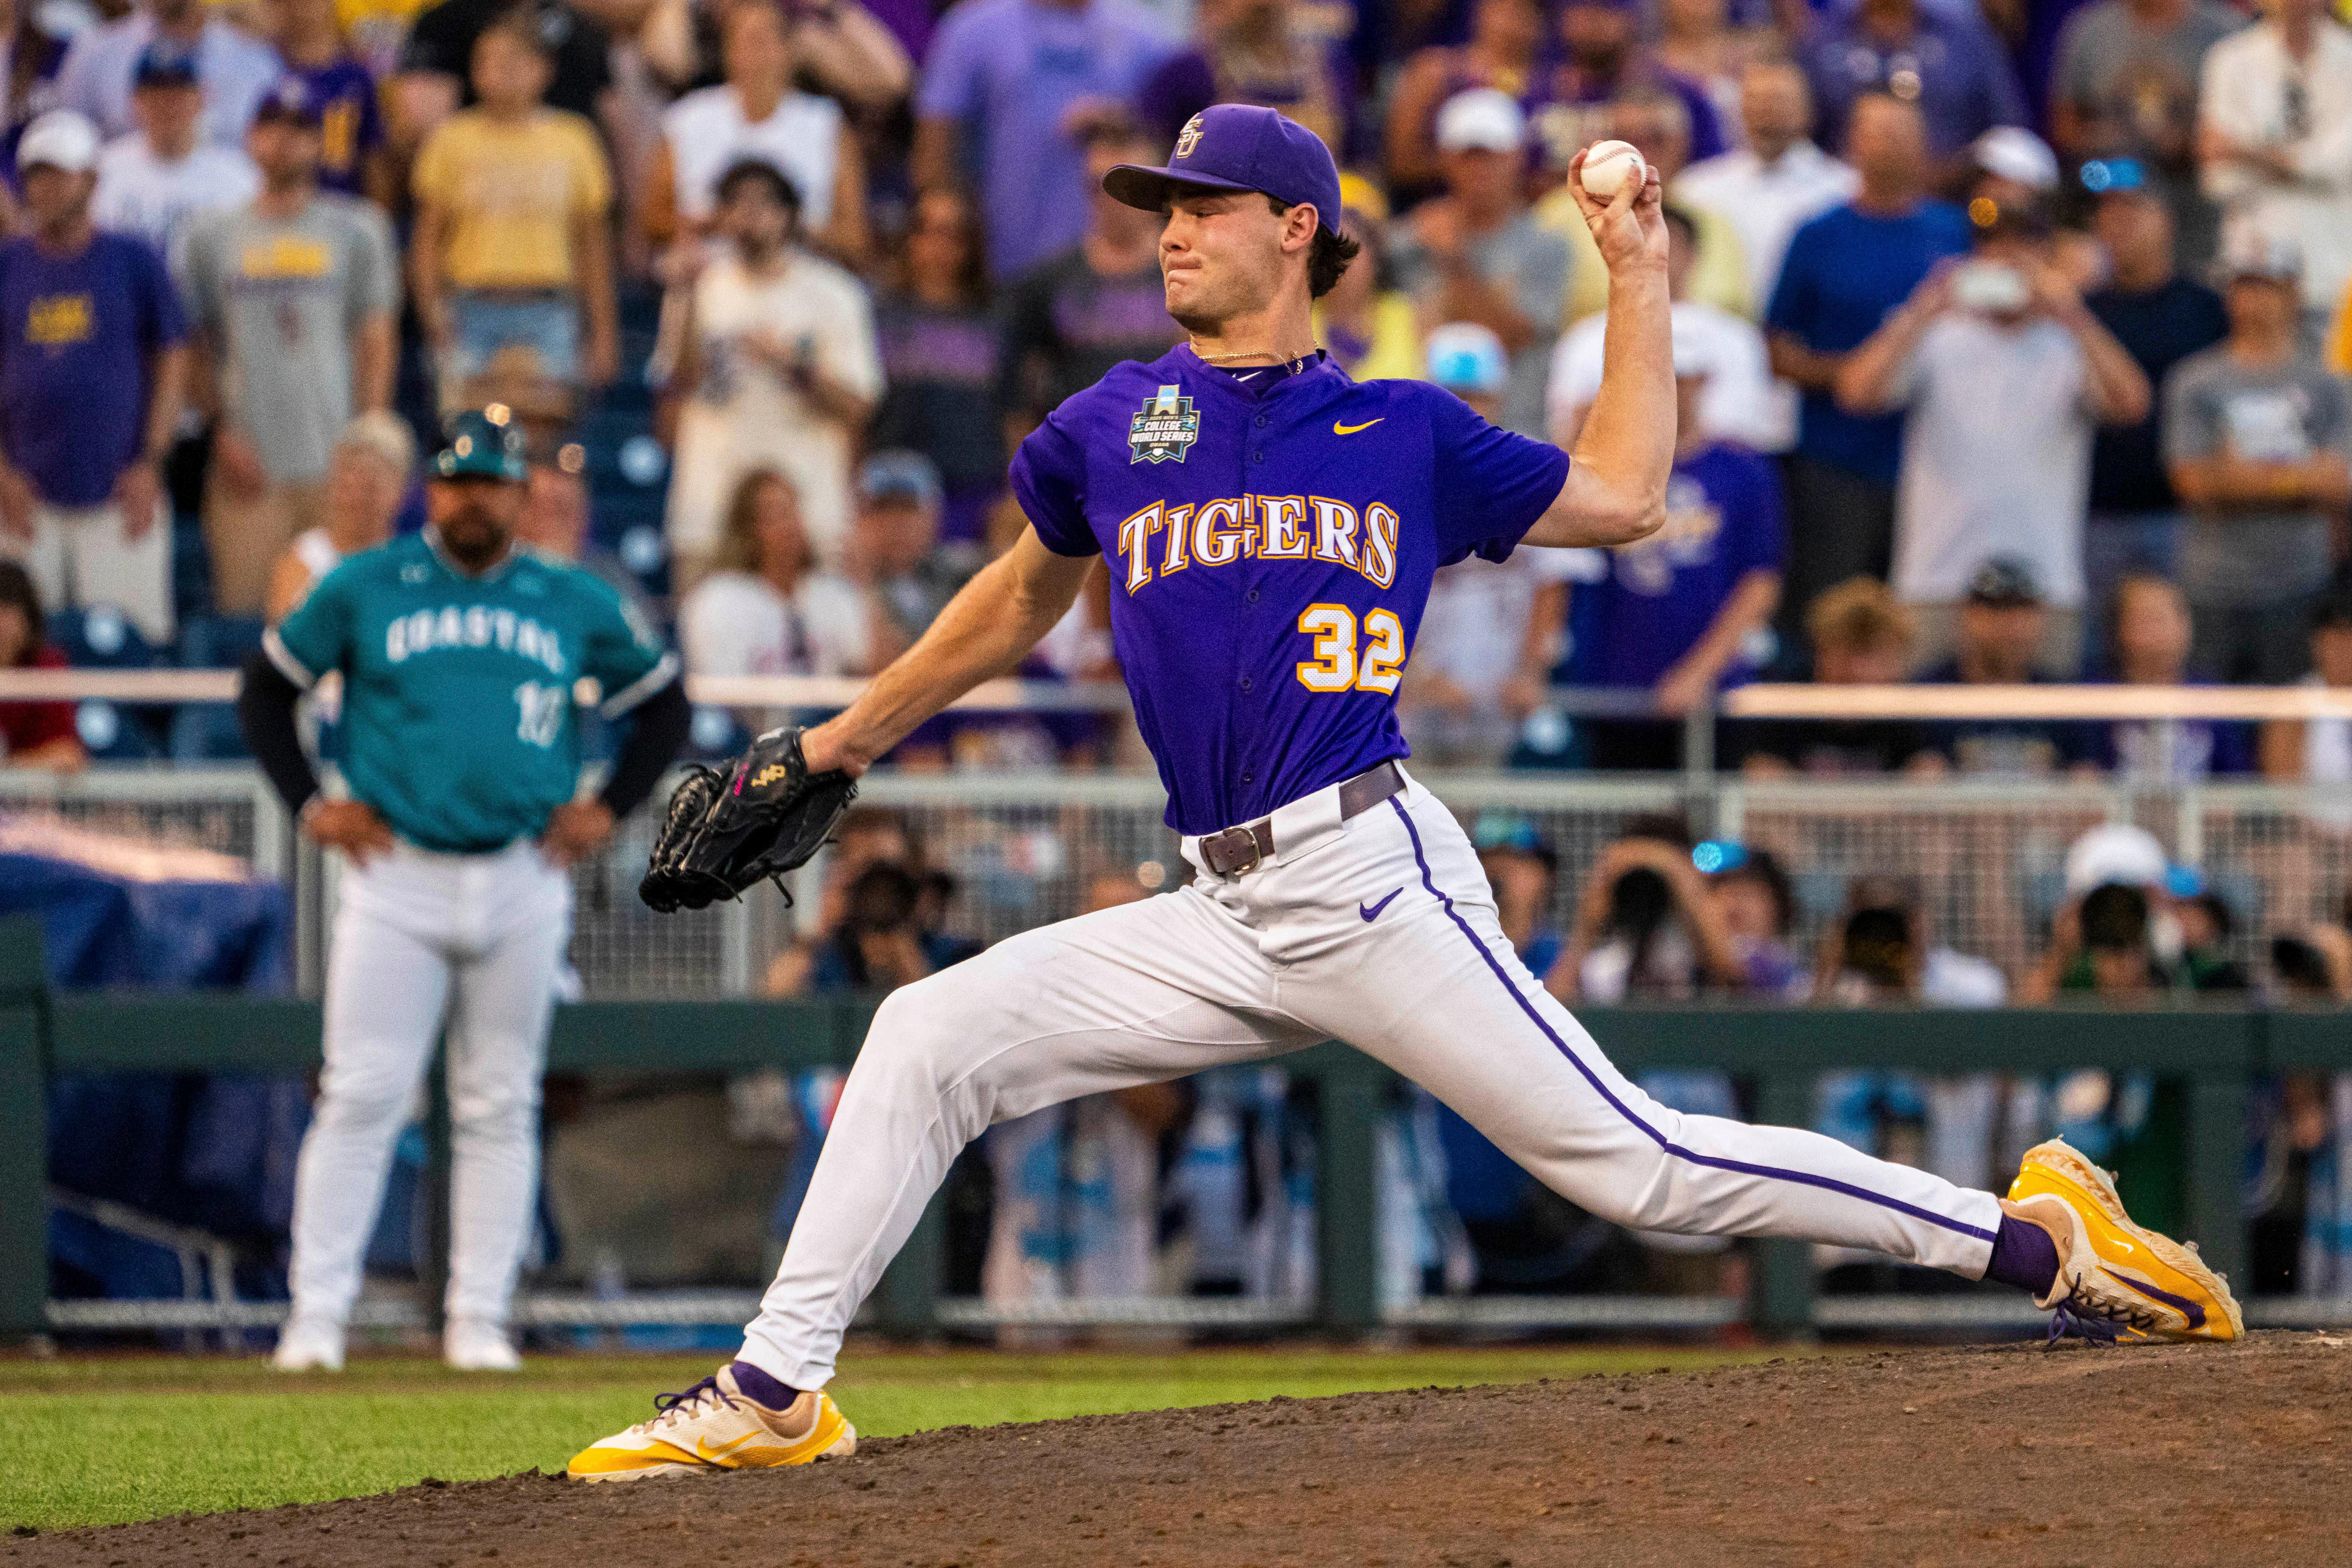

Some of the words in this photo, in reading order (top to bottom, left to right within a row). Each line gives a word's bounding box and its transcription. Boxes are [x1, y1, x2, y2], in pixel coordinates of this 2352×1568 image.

[1131, 432, 1160, 443] WORLD
[1160, 431, 1194, 442] SERIES
[1144, 421, 1182, 431] COLLEGE
[1119, 493, 1399, 597] TIGERS
[1297, 603, 1405, 696] 32
